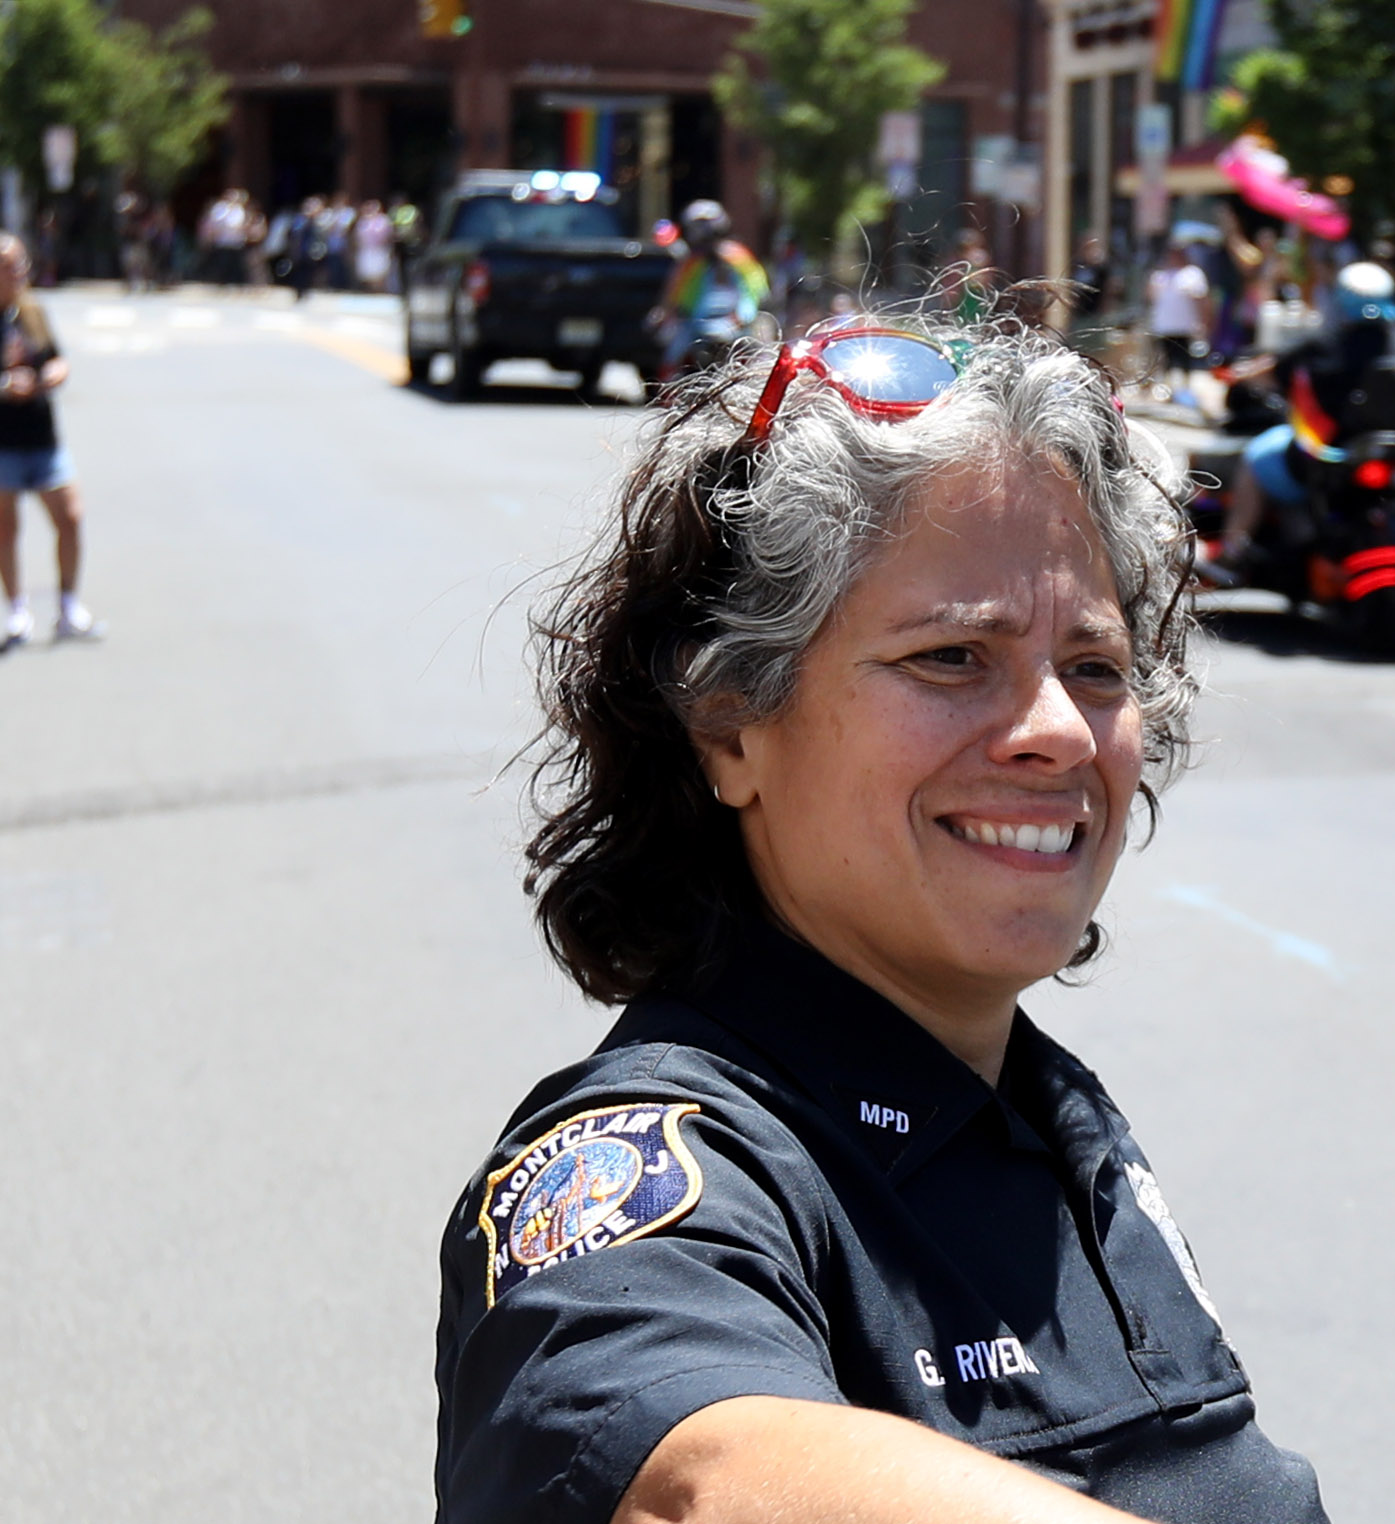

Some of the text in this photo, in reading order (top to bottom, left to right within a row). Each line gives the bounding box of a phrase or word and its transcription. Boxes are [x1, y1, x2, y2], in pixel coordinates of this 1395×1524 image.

[860, 1100, 910, 1134] MPD
[492, 1111, 661, 1219] MONTCLAIR
[914, 1348, 946, 1387] G.
